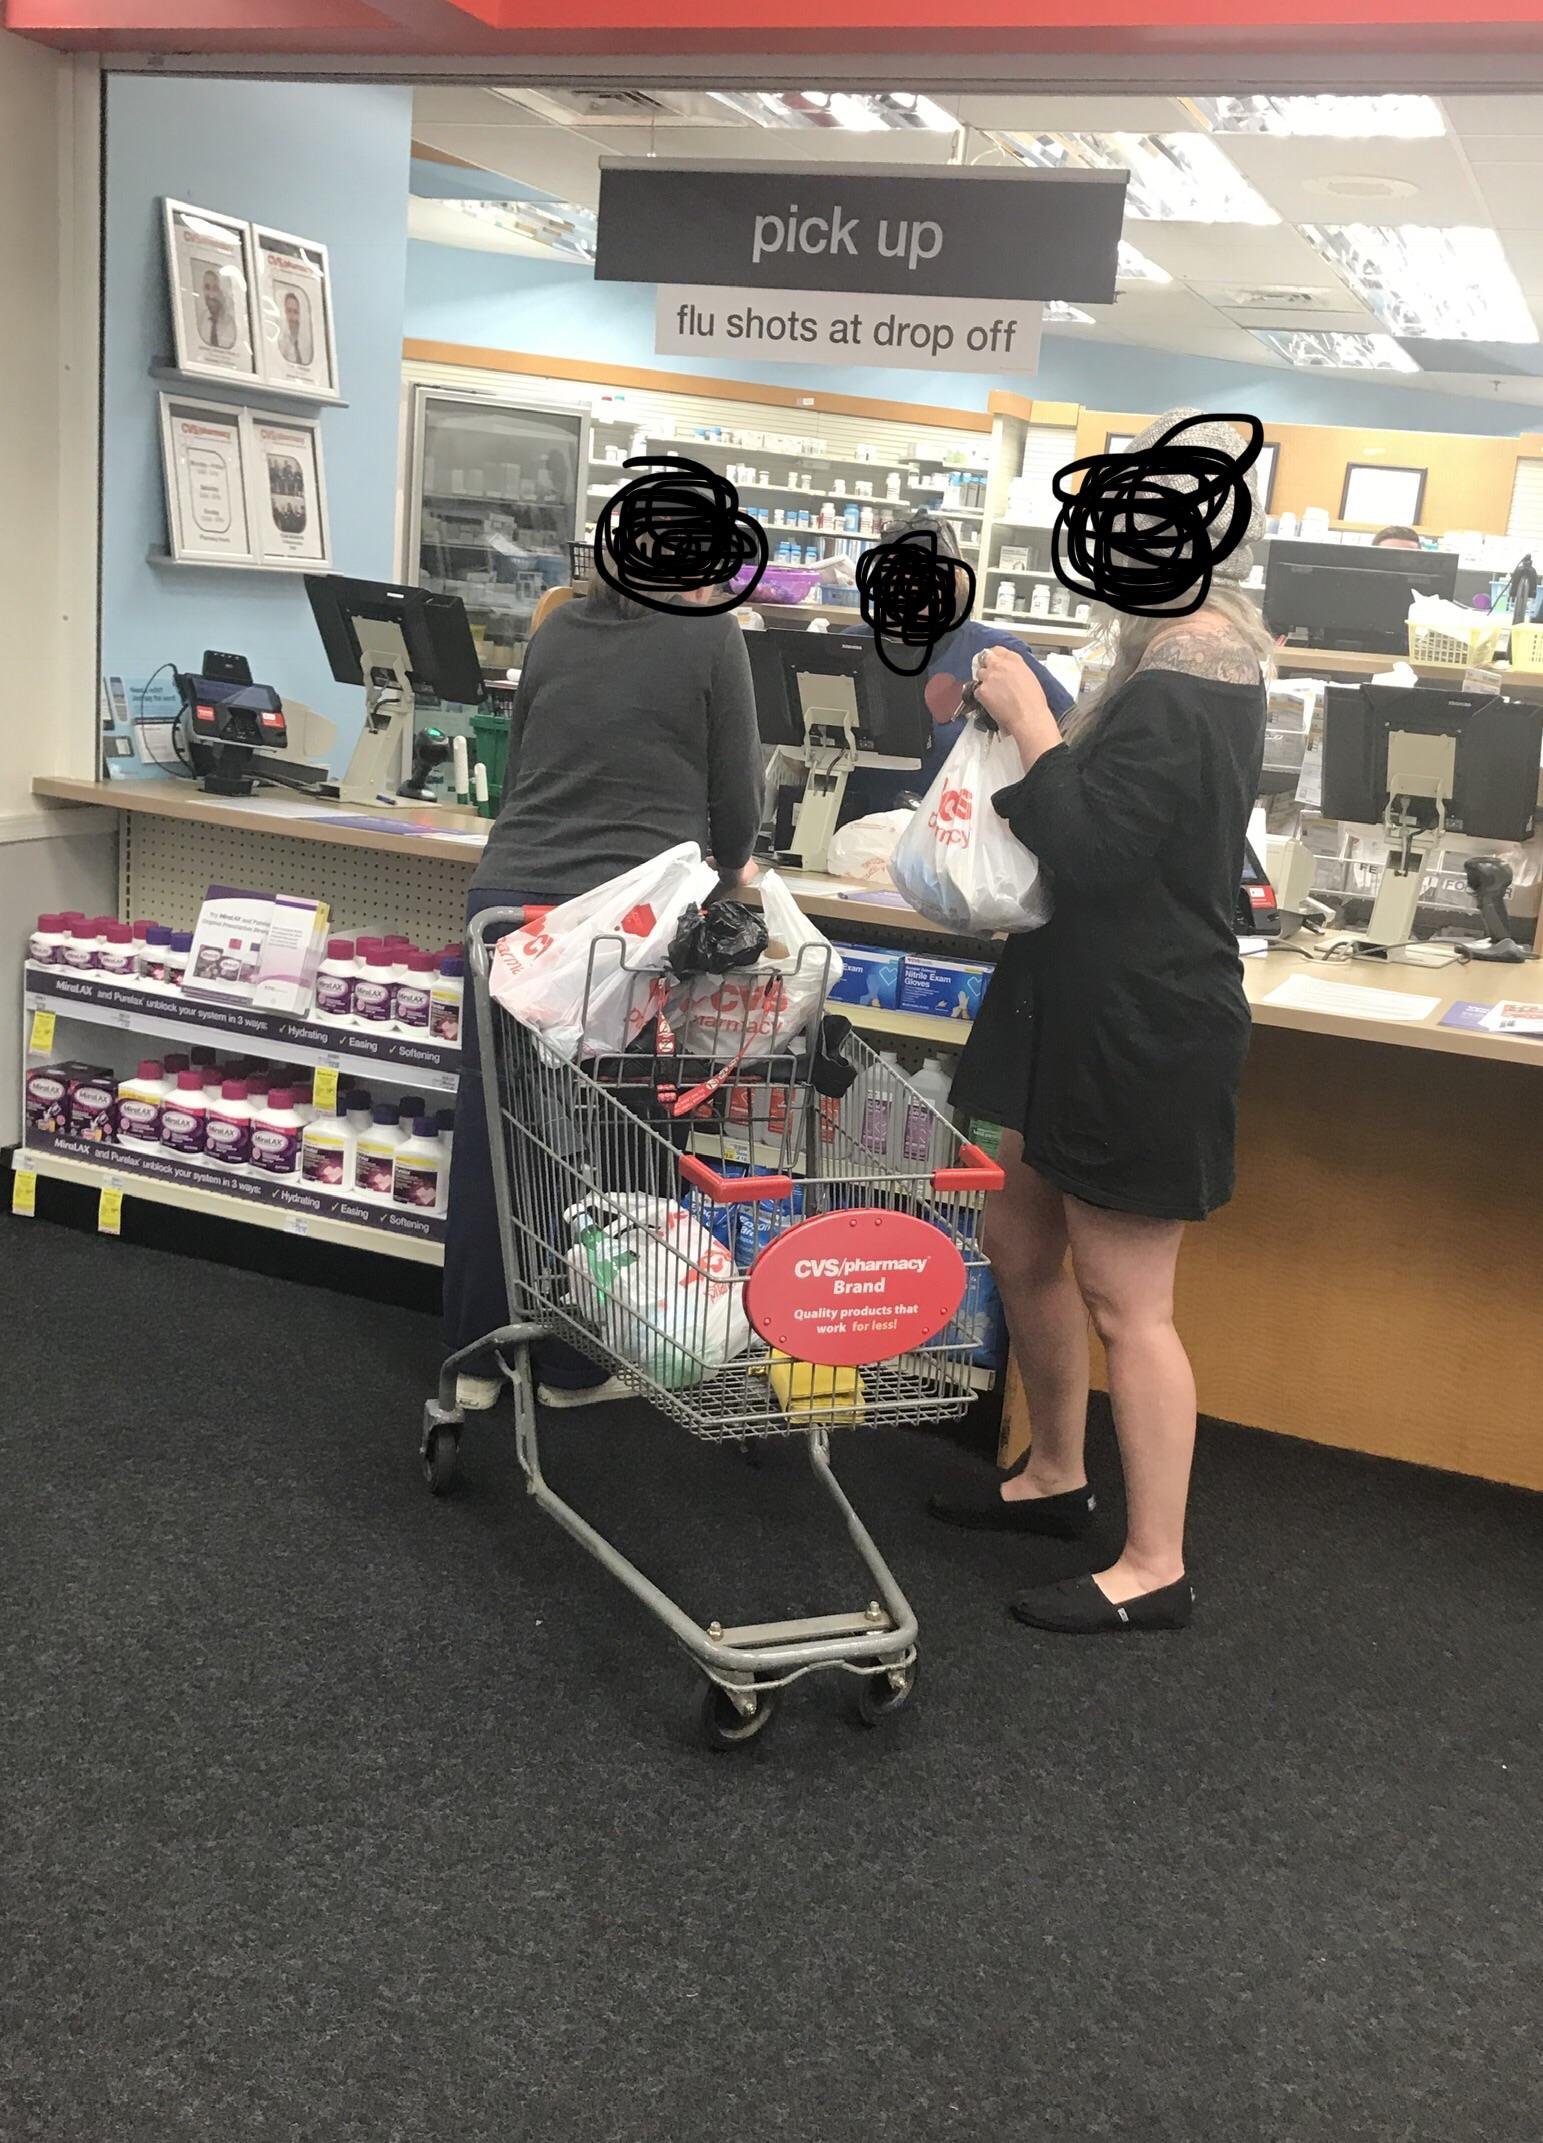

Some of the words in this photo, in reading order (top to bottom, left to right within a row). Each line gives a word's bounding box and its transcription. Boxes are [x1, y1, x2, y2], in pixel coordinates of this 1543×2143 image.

[751, 204, 859, 263] pick
[878, 218, 944, 270] up
[676, 304, 715, 338] flu
[726, 307, 818, 342] shots
[829, 314, 862, 344] at
[873, 314, 954, 357] drop
[966, 319, 1018, 353] off
[904, 978, 930, 989] Gloves
[905, 970, 928, 981] Nitrile
[929, 973, 952, 984] Exam
[56, 980, 93, 996] MiraLAX
[97, 990, 113, 1000] and
[146, 999, 178, 1013] unblock
[179, 1006, 196, 1016] your
[197, 1010, 227, 1023] system
[228, 1015, 236, 1023] in
[237, 1015, 244, 1025] 3
[288, 1025, 328, 1043] Hydrating
[349, 1037, 378, 1053] Easing
[399, 1046, 440, 1064] Softening
[54, 1138, 90, 1155] MiraLAX
[95, 1149, 110, 1159] and
[143, 1160, 174, 1174] unblock
[175, 1168, 191, 1178] your
[193, 1173, 222, 1186] system
[223, 1177, 230, 1186] in
[231, 1180, 238, 1189] 3
[281, 1190, 321, 1209] Hydrating
[341, 1203, 369, 1220] Easing
[389, 1214, 430, 1233] Softening
[794, 1257, 928, 1279] CVS/pharmacy
[833, 1277, 886, 1295] Brand
[794, 1308, 838, 1321] Quality
[840, 1305, 893, 1319] products
[894, 1304, 919, 1315] that
[816, 1322, 847, 1334] work
[852, 1321, 870, 1332] for
[871, 1319, 898, 1331] less!
